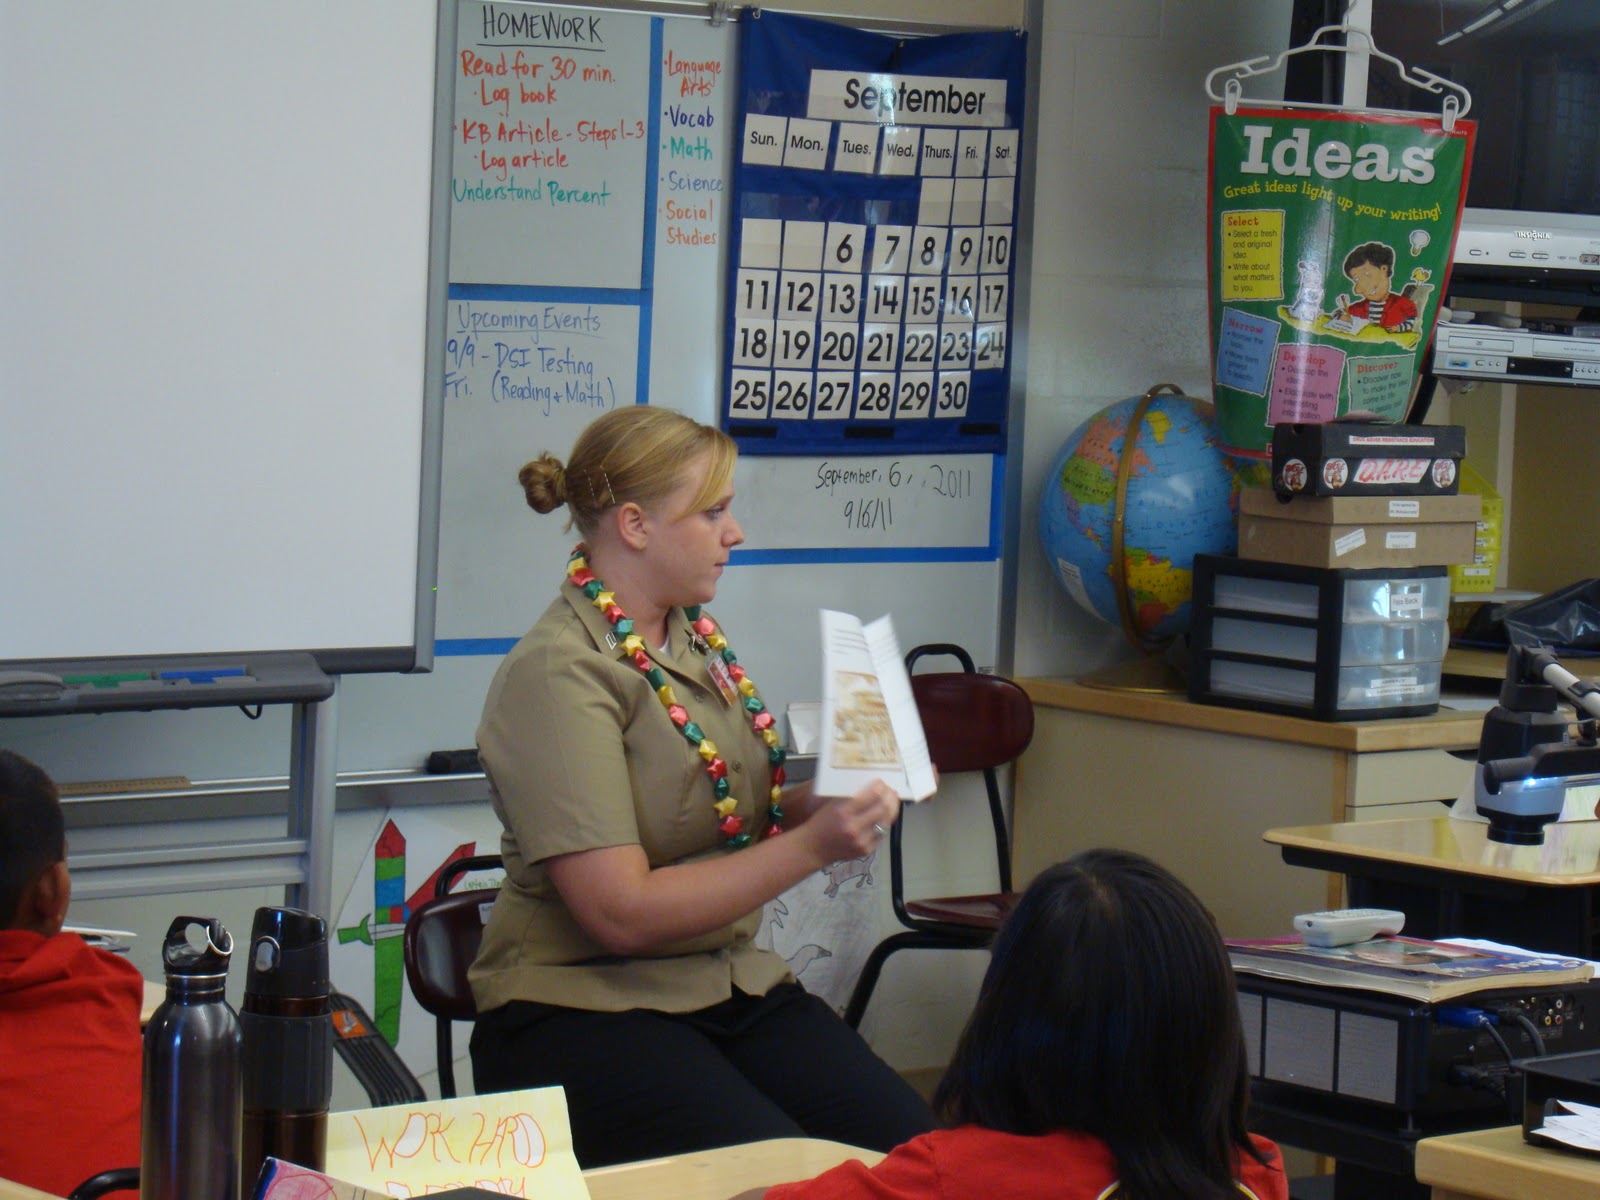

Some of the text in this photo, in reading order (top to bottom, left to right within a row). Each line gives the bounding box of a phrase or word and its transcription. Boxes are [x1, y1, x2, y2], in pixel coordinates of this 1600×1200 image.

[483, 5, 603, 43] HOMEWORK
[460, 49, 616, 84] Read for 30 min.
[667, 49, 721, 84] Language
[520, 82, 557, 105] book
[680, 76, 712, 98] Arts
[844, 78, 986, 118] September
[669, 104, 714, 128] Vocab
[462, 118, 491, 144] KB
[498, 117, 566, 144] Article
[577, 119, 617, 150] Steps
[671, 136, 713, 160] Math
[750, 131, 1012, 159] Sun. Mon. Tues. Wed. Thurs. Fri. Sat.
[481, 147, 569, 181] Log article
[1240, 125, 1436, 184] Ideas
[453, 176, 613, 207] Understand Percent
[669, 170, 724, 192] Science
[666, 200, 713, 222] Social
[1224, 180, 1442, 222] Great ideas light up your writing!
[666, 226, 717, 246] Studies
[1228, 216, 1259, 226] Select
[836, 234, 1007, 266] 6 7 8 9 10
[745, 280, 1004, 315] 11 12 13 14 15 16 17
[457, 301, 601, 344] Upcoming Events
[447, 335, 475, 369] 9/9
[537, 347, 593, 378] Testing
[741, 328, 1004, 363] 18 19 20 21 22 23 24
[491, 370, 551, 417] (Reading
[565, 376, 616, 409] Math)
[733, 380, 967, 412] 25 26 27 28 29 30
[930, 464, 971, 498] 2011
[844, 497, 892, 531] 9/6/11
[354, 1112, 461, 1172] WORK
